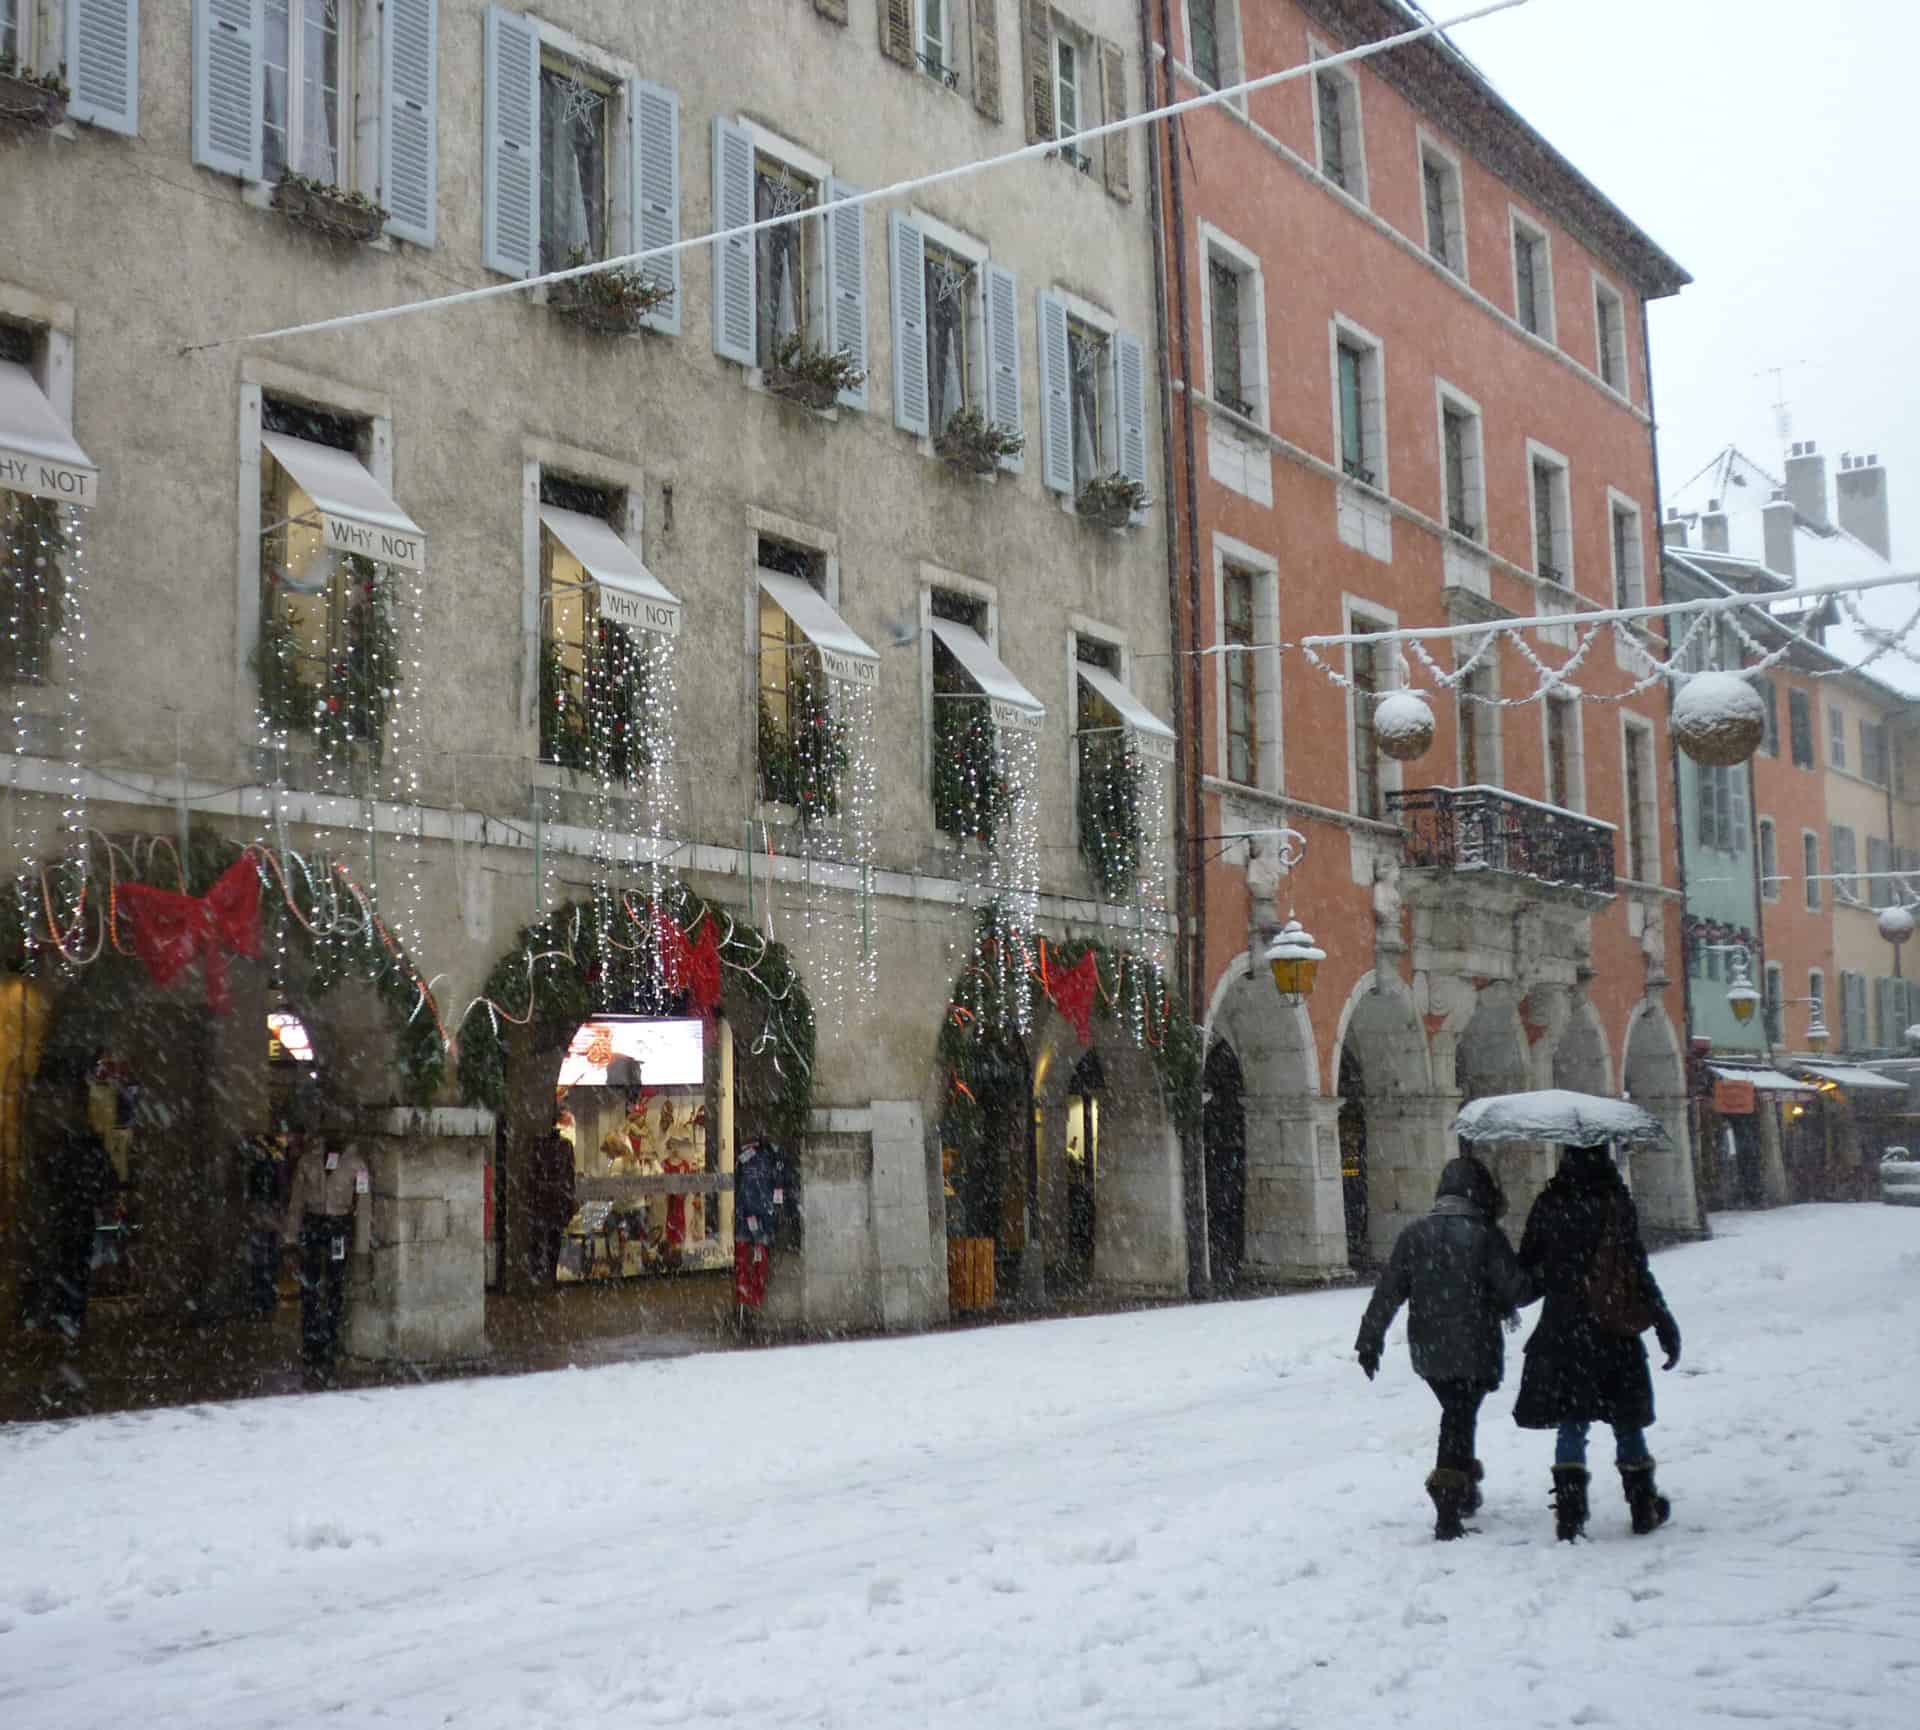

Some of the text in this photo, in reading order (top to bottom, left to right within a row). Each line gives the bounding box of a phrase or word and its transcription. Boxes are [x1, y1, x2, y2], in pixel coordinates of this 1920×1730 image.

[0, 457, 89, 496] HY NOT
[331, 519, 417, 560] WHY NOT
[606, 592, 675, 628] WHY NOT
[853, 660, 875, 680] NOT
